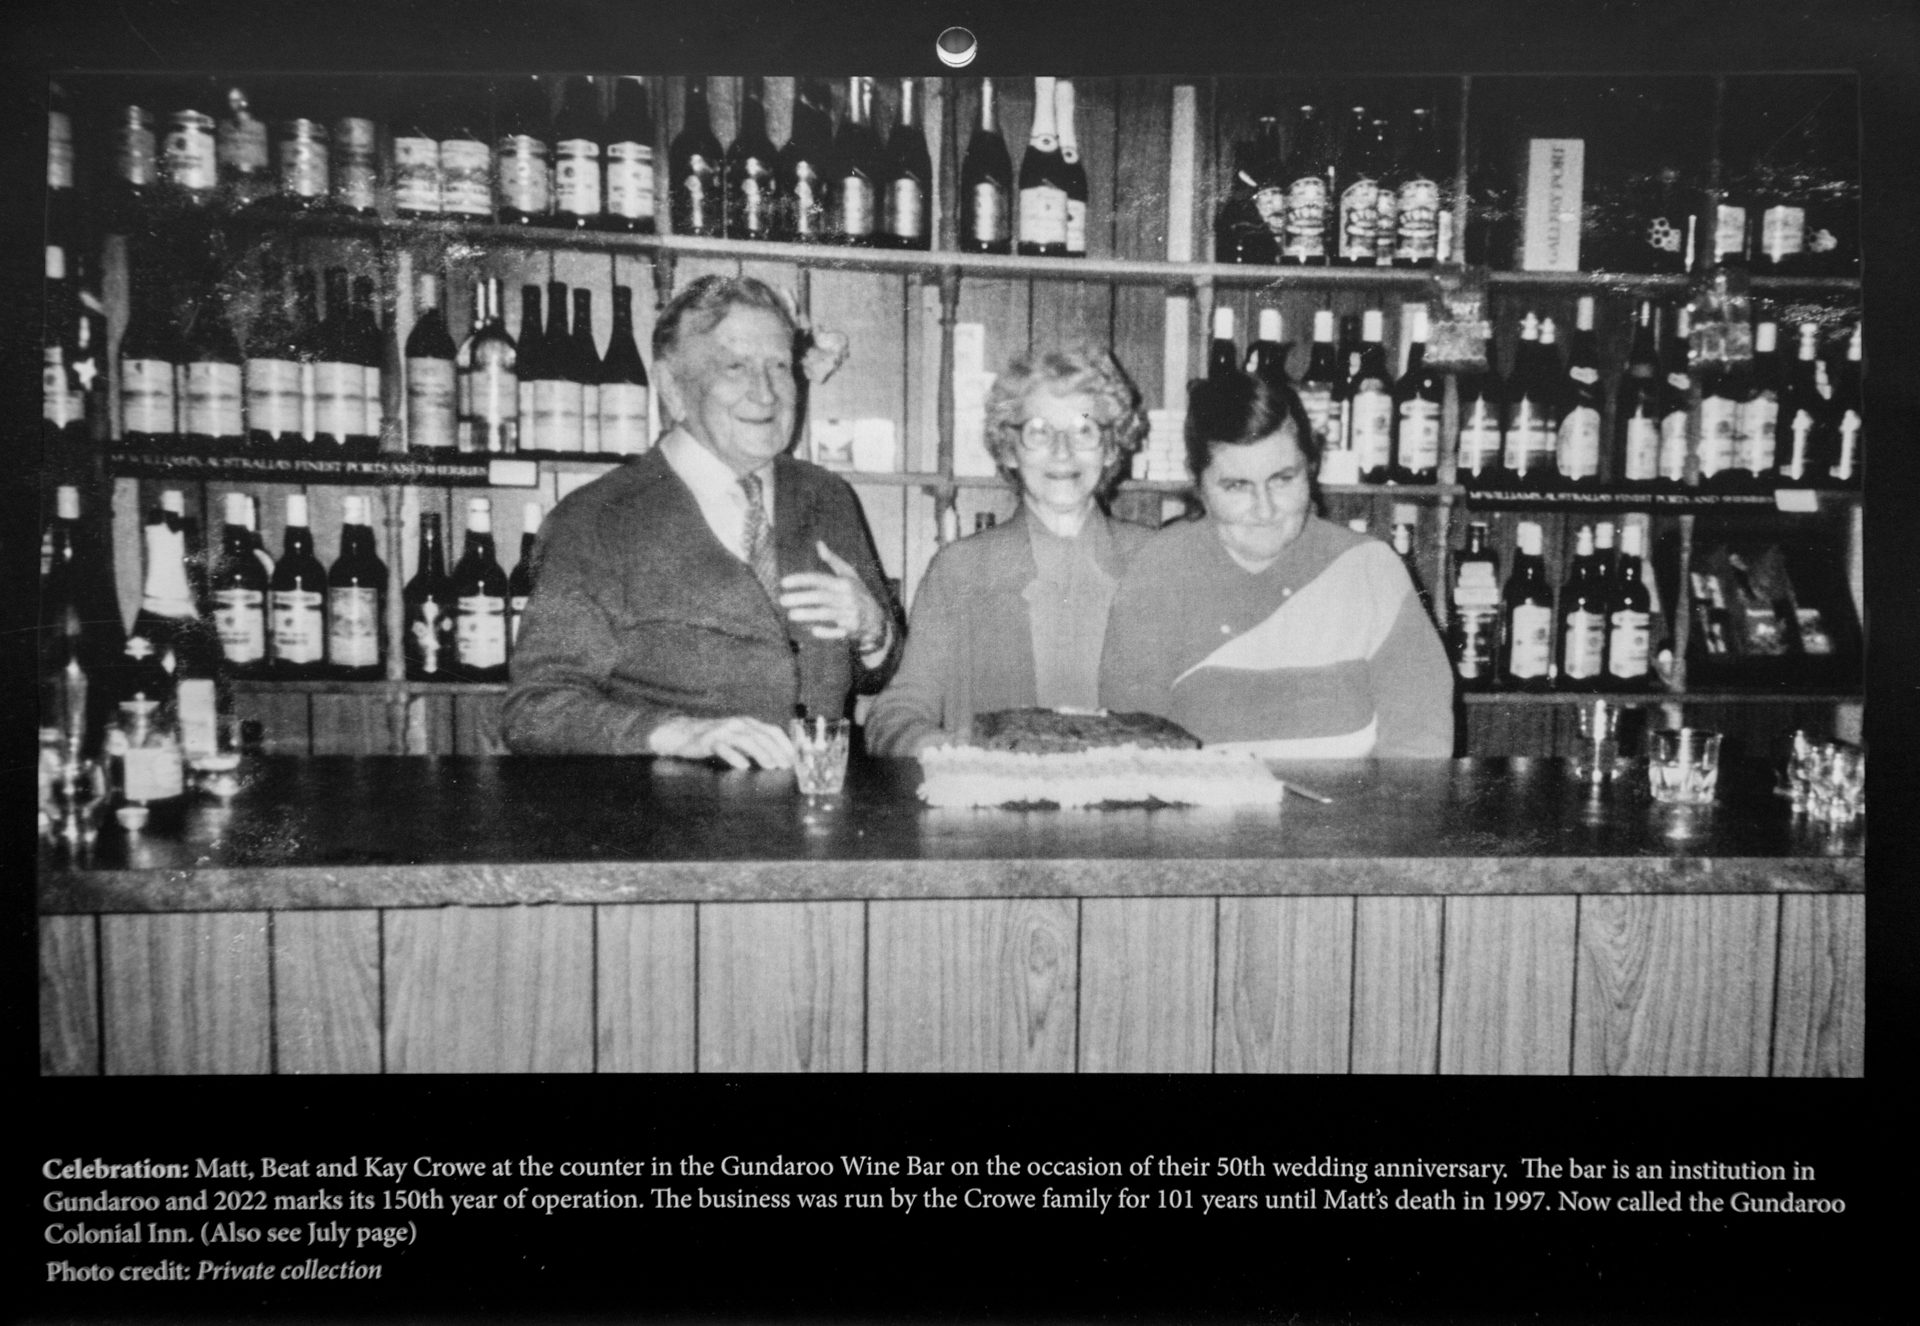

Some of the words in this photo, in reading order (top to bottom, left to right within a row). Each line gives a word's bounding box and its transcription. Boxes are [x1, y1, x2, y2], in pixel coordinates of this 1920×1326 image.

[42, 1157, 189, 1180] Celebration:
[195, 1157, 255, 1181] Matt,
[260, 1157, 310, 1178] Beat
[315, 1155, 358, 1178] and
[364, 1156, 408, 1184] Kay
[413, 1156, 487, 1178] Crowe
[491, 1159, 513, 1177] at
[518, 1154, 554, 1177] the
[559, 1158, 645, 1177] counter
[651, 1156, 673, 1176] in
[679, 1154, 715, 1176] the
[720, 1154, 834, 1176] Gundaroo
[839, 1155, 900, 1176] Wine
[906, 1155, 946, 1176] Bar
[950, 1161, 980, 1176] on
[985, 1154, 1021, 1176] the
[1026, 1156, 1123, 1176] occasion
[1129, 1154, 1155, 1177] of
[1157, 1154, 1211, 1177] their
[1216, 1155, 1266, 1177] 50th
[1272, 1155, 1369, 1184] wedding
[1374, 1157, 1508, 1185] anniversary.
[1521, 1156, 1564, 1179] The
[1568, 1157, 1607, 1179] bar
[1612, 1159, 1630, 1180] is
[1635, 1164, 1663, 1180] an
[1669, 1159, 1786, 1181] institution
[1793, 1160, 1816, 1181] in
[43, 1189, 160, 1212] Gundaroo
[165, 1188, 208, 1211] and
[213, 1190, 268, 1211] 2022
[273, 1188, 344, 1210] marks
[349, 1189, 376, 1210] its
[383, 1187, 444, 1210] 150th
[449, 1194, 498, 1216] year
[503, 1187, 531, 1210] of
[530, 1189, 644, 1216] operation.
[650, 1187, 693, 1209] The
[697, 1187, 791, 1209] business
[796, 1193, 838, 1208] was
[844, 1193, 884, 1209] run
[890, 1186, 918, 1215] by
[922, 1186, 958, 1209] the
[964, 1187, 1036, 1209] Crowe
[1042, 1186, 1113, 1215] family
[1118, 1186, 1151, 1209] for
[1158, 1189, 1194, 1209] 101
[1201, 1194, 1259, 1216] years
[1264, 1187, 1317, 1210] until
[1323, 1188, 1389, 1210] Matt’s
[1394, 1188, 1457, 1211] death
[1463, 1190, 1486, 1211] in
[1493, 1190, 1552, 1211] 1997.
[1558, 1190, 1612, 1212] Now
[1616, 1190, 1683, 1212] called
[1688, 1190, 1725, 1213] the
[1730, 1191, 1846, 1214] Gundaroo
[44, 1221, 142, 1244] Colonial
[147, 1222, 194, 1243] Inn.
[200, 1221, 262, 1247] (Also
[267, 1227, 302, 1243] see
[307, 1220, 351, 1249] July
[356, 1221, 417, 1249] page)
[46, 1260, 115, 1282] Photo
[119, 1259, 191, 1282] credit:
[196, 1260, 276, 1281] Private
[280, 1258, 382, 1280] collection
